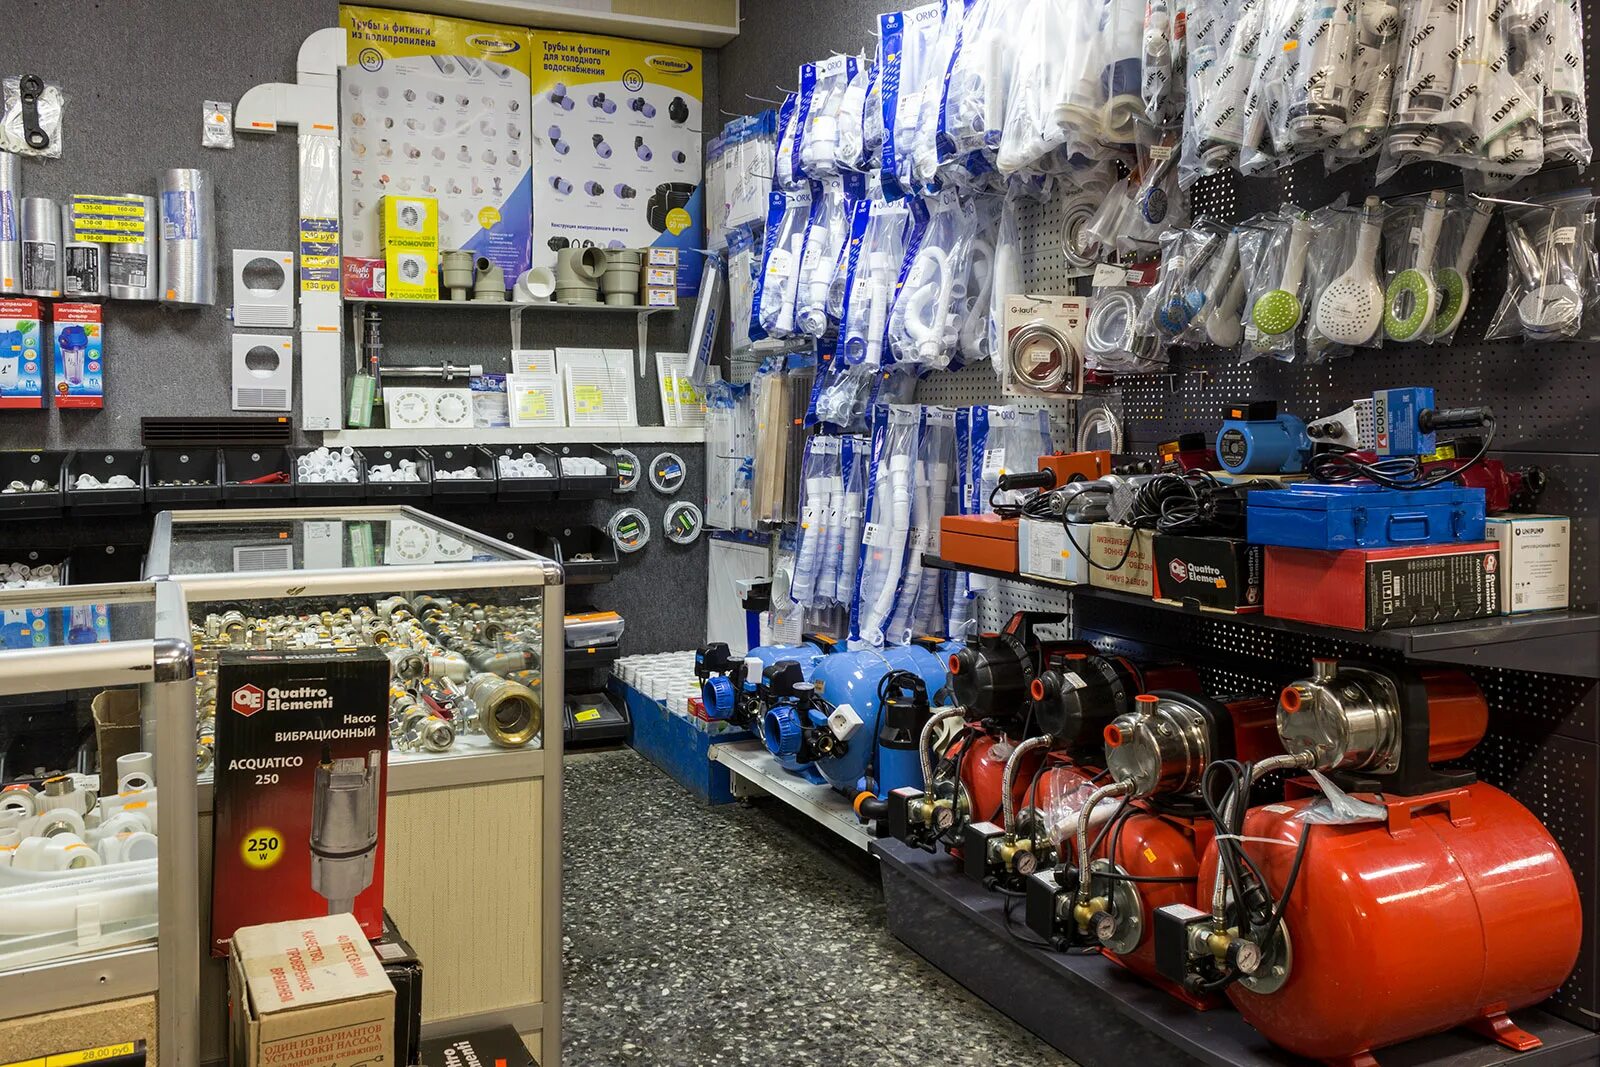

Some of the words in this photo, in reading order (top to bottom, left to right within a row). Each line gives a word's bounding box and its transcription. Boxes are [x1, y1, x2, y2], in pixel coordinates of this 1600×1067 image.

[915, 9, 939, 22] ORIO
[351, 17, 381, 31] Трубы
[383, 23, 389, 31] и
[391, 22, 431, 37] фитинги
[1196, 18, 1215, 40] IDDIS
[1219, 23, 1236, 47] IDDIS
[1283, 16, 1304, 41] IDDIS
[1307, 21, 1331, 47] IDDIS
[1409, 23, 1435, 49] IDDIS
[351, 30, 363, 40] из
[365, 32, 436, 48] полипропилена
[542, 40, 569, 53] Трубы
[570, 45, 576, 53] и
[577, 44, 611, 57] фитинги
[1242, 31, 1262, 54] IDDIS
[1448, 34, 1476, 61] IDDIS
[366, 55, 376, 65] 25
[543, 53, 559, 62] для
[560, 54, 601, 66] холодного
[543, 64, 605, 76] водоснабжения
[1215, 63, 1235, 87] IDDIS
[628, 76, 638, 85] 16
[1408, 72, 1436, 98] IDDIS
[1244, 93, 1258, 118] IDDIS
[1449, 82, 1478, 110] IDDIS
[1214, 105, 1235, 128] IDDIS
[1491, 95, 1521, 123] IDDIS
[320, 233, 336, 242] руб
[321, 283, 336, 292] руб
[1375, 399, 1385, 434] СОЮЗ
[1521, 527, 1545, 535] UNIPUMP
[1187, 562, 1220, 575] Quattro
[1247, 549, 1255, 585] Quattro
[234, 689, 261, 709] QE
[267, 686, 327, 700] Quattro
[266, 696, 334, 712] Elementi
[343, 713, 377, 725] Насос
[275, 726, 376, 743] ВИБРАЦИОННЫЙ
[228, 755, 304, 771] ACQUATICO
[254, 772, 280, 786] 250
[247, 836, 279, 853] 250
[259, 852, 269, 862] W
[286, 947, 315, 992] ПРОВЕРЕННОЕ
[263, 1042, 334, 1066] УСТАНОВКИ
[336, 1033, 382, 1050] НАСОСА
[264, 1040, 298, 1056] ОДИН
[300, 1037, 315, 1048] ИЗ
[316, 1023, 383, 1045] ВАРИАНТОВ
[82, 1047, 110, 1061] 28.00
[111, 1044, 130, 1058] руб
[316, 1052, 335, 1064] или
[335, 1043, 383, 1060] скважине)
